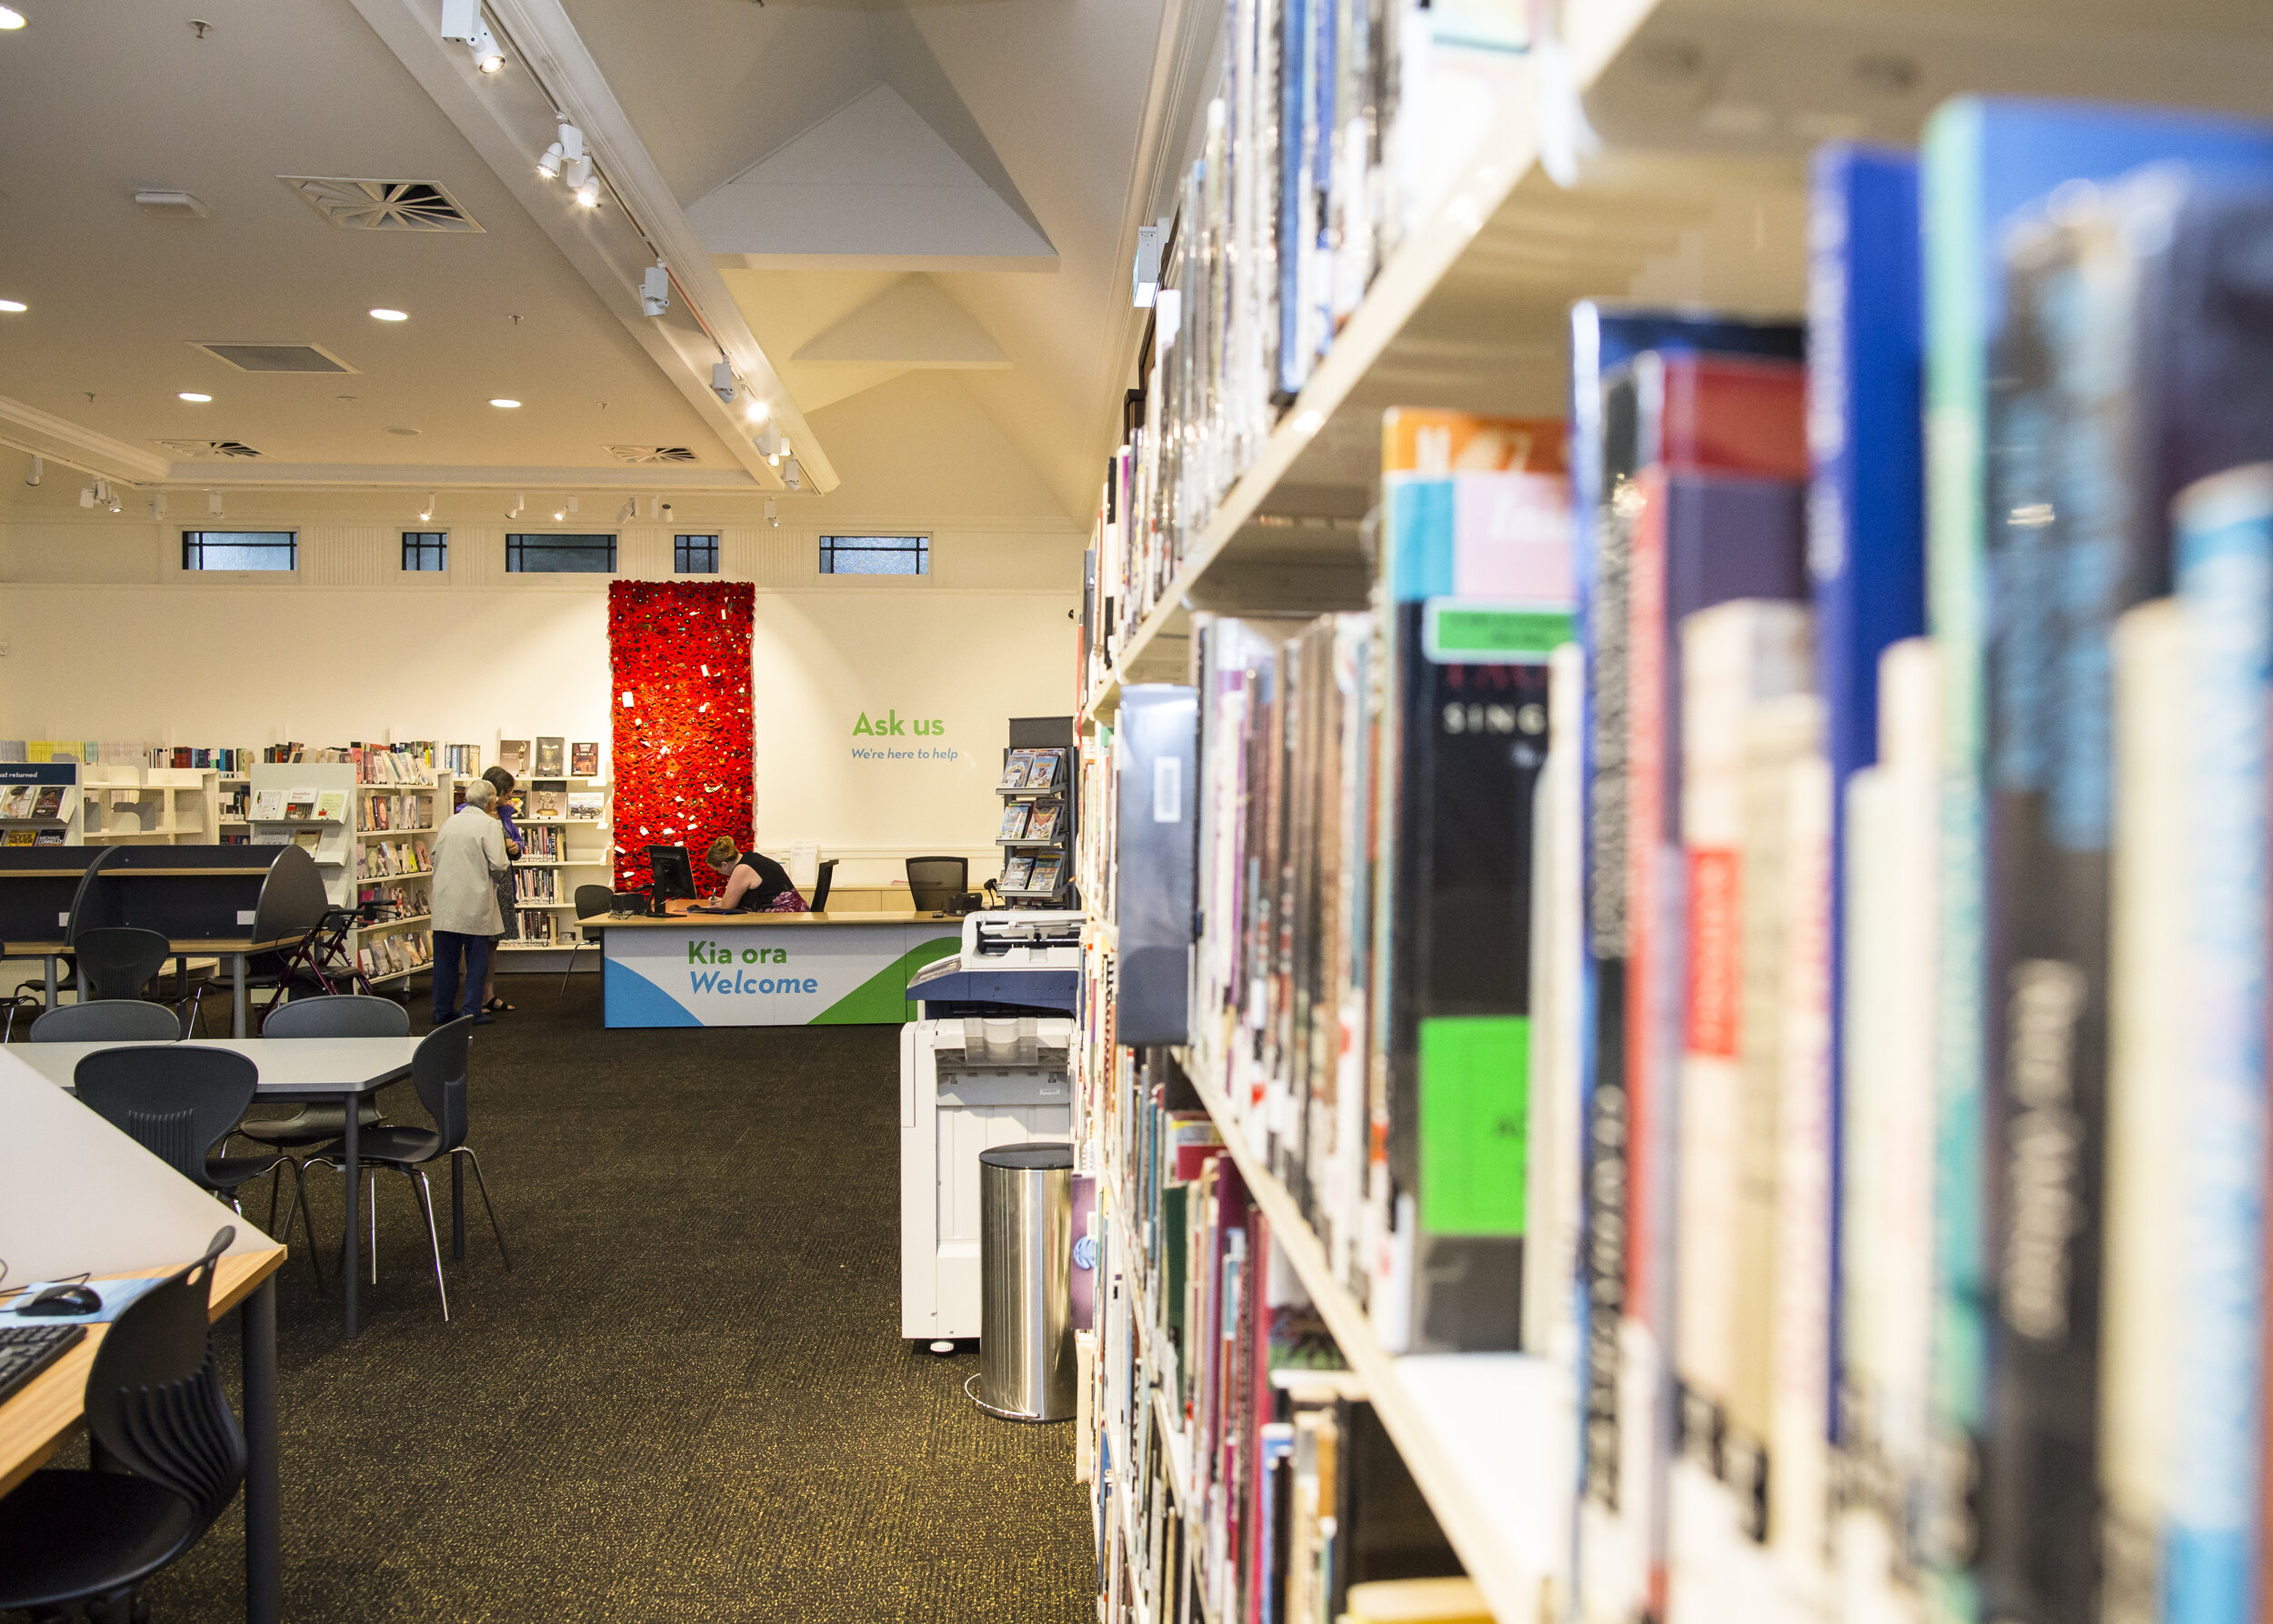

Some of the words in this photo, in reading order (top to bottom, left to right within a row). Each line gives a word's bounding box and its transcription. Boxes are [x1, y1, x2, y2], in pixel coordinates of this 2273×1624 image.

[852, 709, 906, 736] Ask
[913, 719, 945, 736] us
[852, 747, 885, 759] We're
[886, 747, 915, 759] here
[917, 748, 930, 759] to
[932, 747, 958, 762] help
[688, 940, 733, 965] Kia
[741, 947, 787, 965] ora
[690, 969, 818, 995] Welcome
